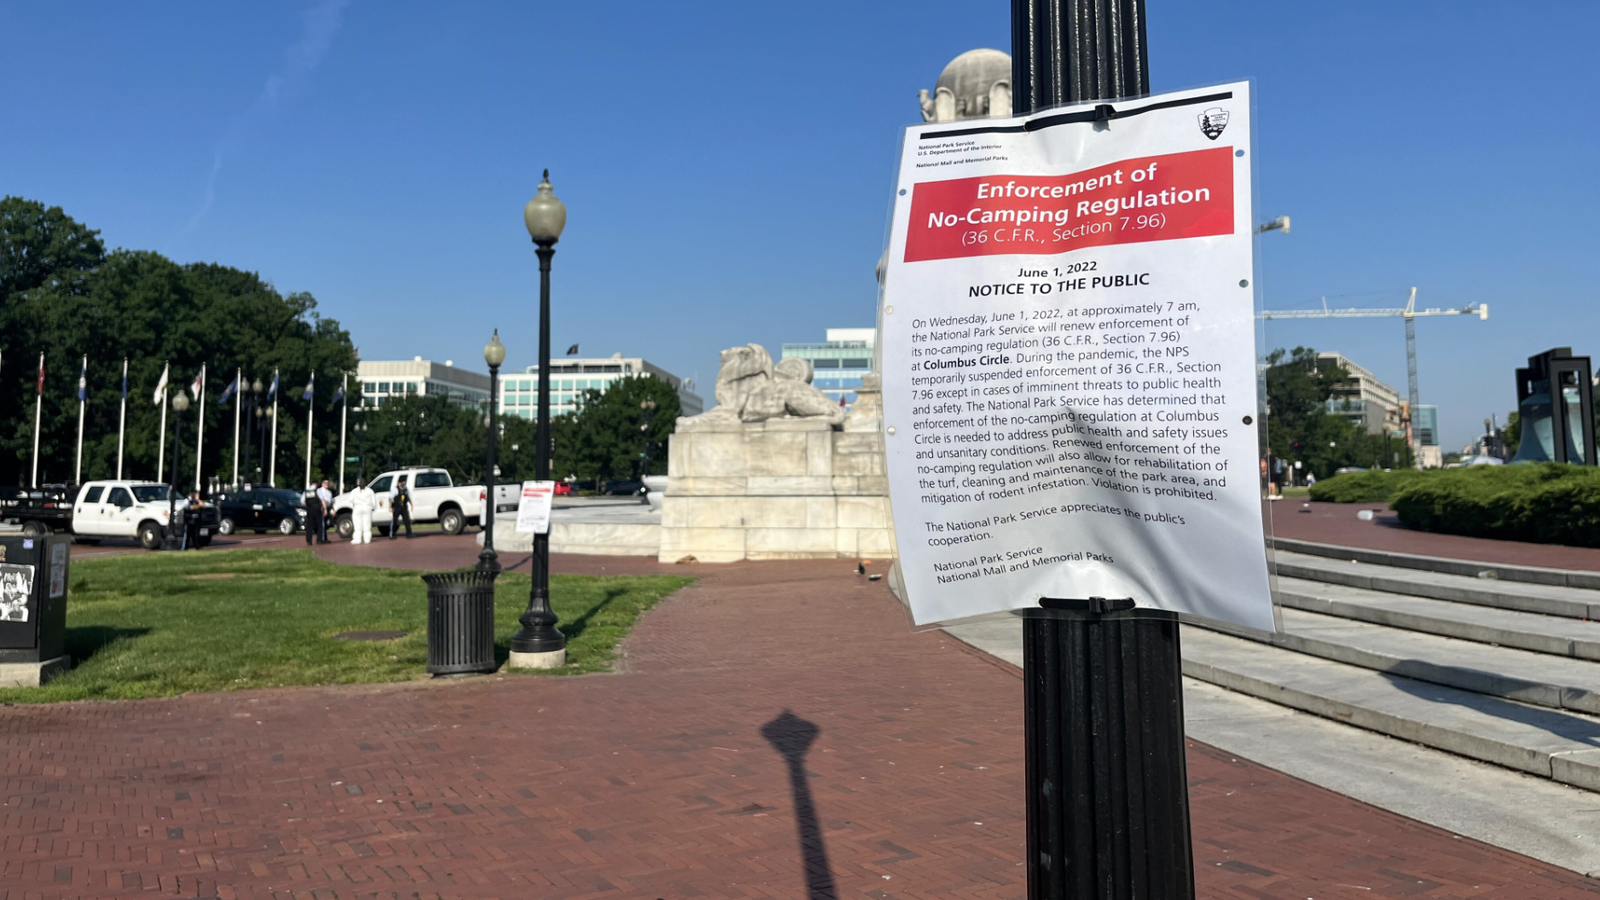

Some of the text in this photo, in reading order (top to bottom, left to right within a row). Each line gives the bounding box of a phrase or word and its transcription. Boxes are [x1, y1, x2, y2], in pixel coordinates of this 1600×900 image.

[977, 162, 1158, 200] Enforcement of
[927, 187, 1211, 228] No-Camping Regulation
[961, 212, 1167, 247] (36 C.F.R., Section 7.96)
[1018, 261, 1097, 277] June 1, 2022
[969, 273, 1150, 297] NOTICE TO THE PUBLIC
[912, 301, 1200, 328] On Wednesday, June 1, 2022, at approximately 7 am,
[912, 315, 1189, 342] the National Park Service will renew enforcement of
[912, 331, 1181, 357] its no-camping regulation (36 C.F.R., Section 7.96)
[911, 346, 1189, 371] at Columbus Circle. During the pandemic, the NPS
[912, 361, 1221, 386] temporarily suspended enforcement of 36 C.F.R., Section
[912, 377, 1221, 400] 7.96 except in cases of imminent threats to public health
[913, 394, 1226, 415] and safety. The National Park Service has determined that
[913, 410, 1219, 429] enforcement of the no-camping regulation at Columbus
[915, 424, 1228, 444] Circle is needed to address public health and safety issues
[916, 438, 1221, 460] and unsanitary conditions. Renewed enforcement of the
[917, 451, 1228, 475] no-camping regulation will also allow for rehabilitation of
[919, 464, 1226, 489] the turf, cleaning and maintenance of the park area, and
[921, 477, 1217, 505] mitigation of rodent infestation. Violation is prohibited.
[925, 522, 944, 532] The
[947, 518, 991, 531] National
[994, 514, 1017, 525] Park
[1020, 507, 1057, 520] Service
[1061, 503, 1121, 515] appreciates
[1124, 508, 1141, 519] the
[928, 532, 994, 546] cooperation.
[934, 546, 1043, 572] National Park Service
[937, 552, 1114, 584] National Mall and Memorial Parks
